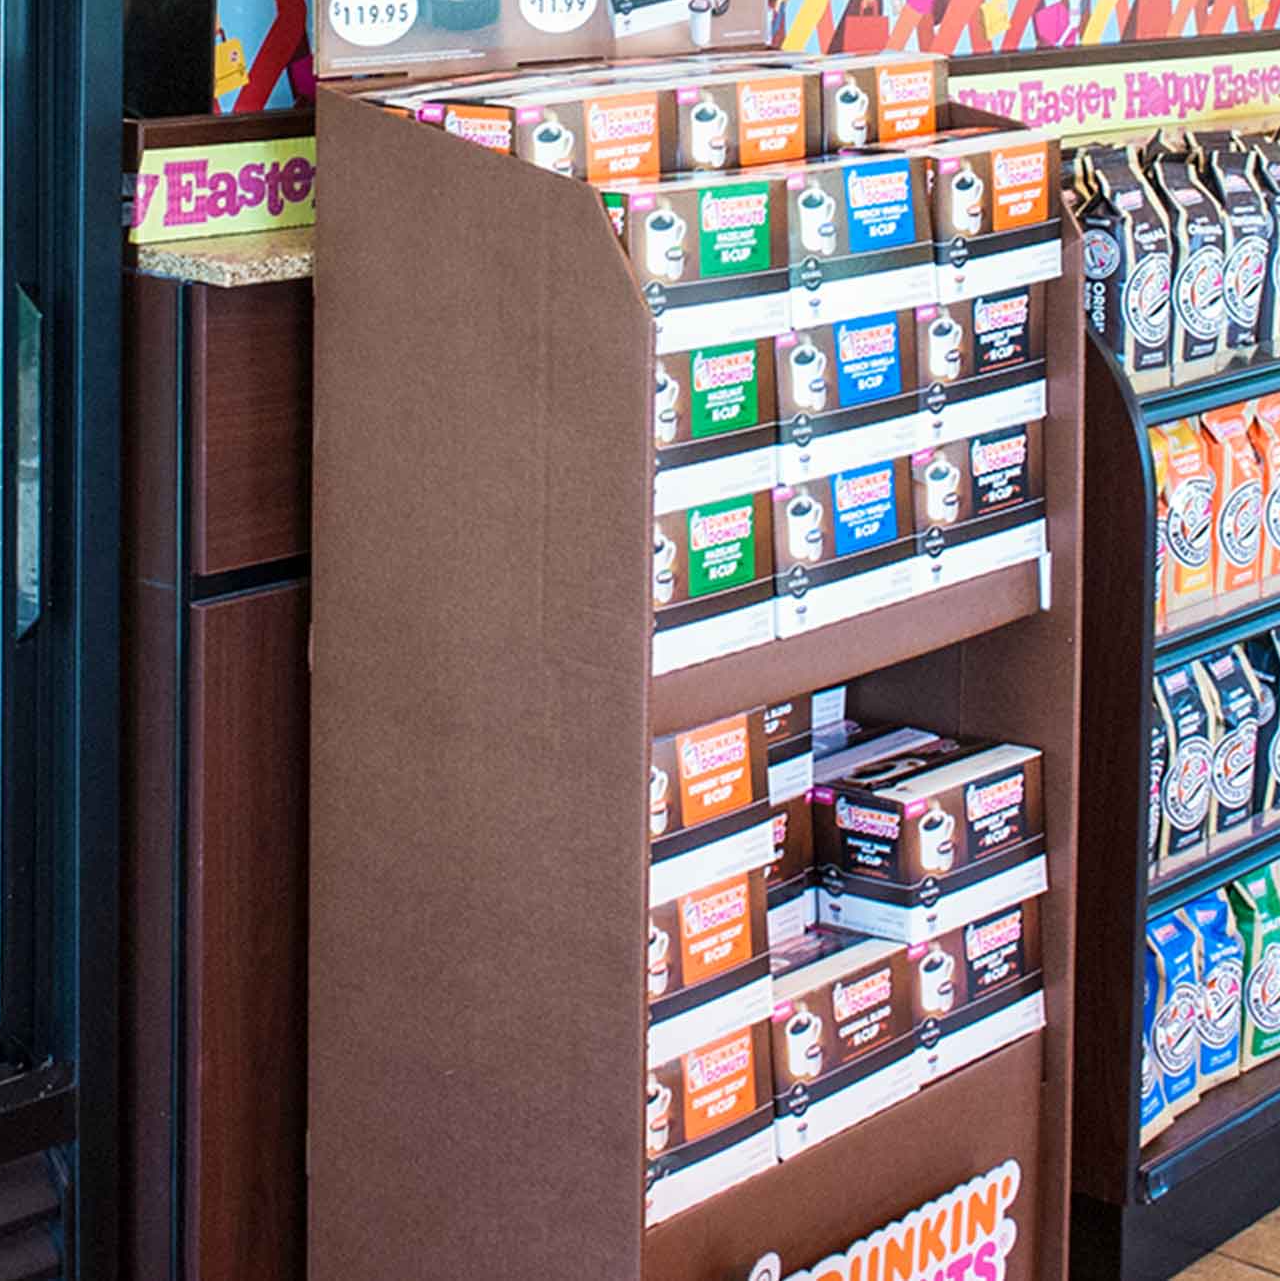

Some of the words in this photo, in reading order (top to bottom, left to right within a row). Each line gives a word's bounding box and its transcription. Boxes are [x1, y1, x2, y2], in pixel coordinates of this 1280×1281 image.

[332, 2, 410, 26] $119.95
[1020, 79, 1118, 127] Easter
[1124, 71, 1211, 119] Happy
[162, 156, 317, 227] Easte
[849, 820, 900, 839] DONUTS
